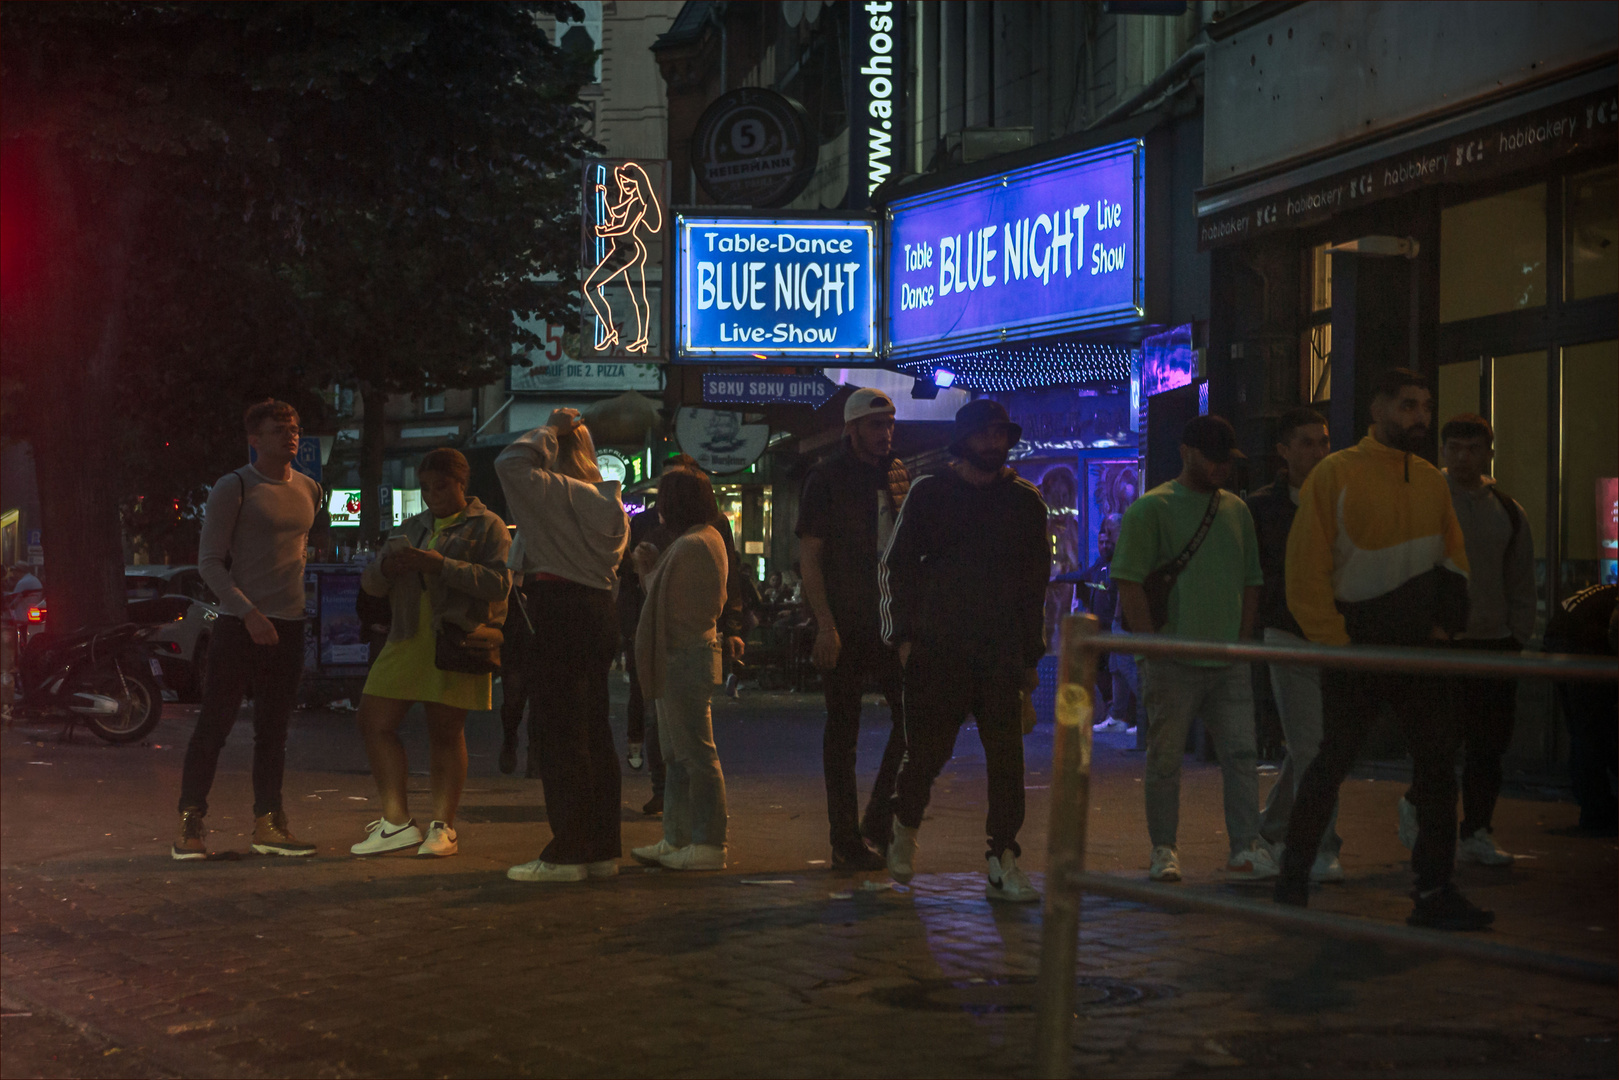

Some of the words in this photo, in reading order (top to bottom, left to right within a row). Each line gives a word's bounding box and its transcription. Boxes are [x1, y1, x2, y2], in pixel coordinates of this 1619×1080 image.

[741, 124, 756, 149] 5
[1498, 114, 1577, 154] habibakery
[709, 157, 791, 178] HEIERMANN
[1383, 153, 1449, 187] habibakery
[1097, 198, 1122, 232] Live
[1286, 186, 1343, 216] habibakery
[1201, 215, 1250, 241] habibakery
[704, 232, 854, 255] Table-Dance
[904, 240, 933, 273] Table
[939, 224, 998, 298] BLUE
[1004, 203, 1091, 287] NIGHT
[1090, 242, 1126, 276] Show
[696, 261, 767, 311] BLUE
[774, 261, 861, 318] NIGHT
[901, 282, 934, 311] Dance
[720, 322, 838, 344] Live-Show
[545, 365, 563, 377] AUF
[567, 365, 582, 377] DIE
[585, 365, 594, 377] 2.
[597, 365, 625, 377] PIZZA
[709, 381, 745, 396] sexy
[749, 381, 785, 397] sexy
[789, 381, 826, 397] girls
